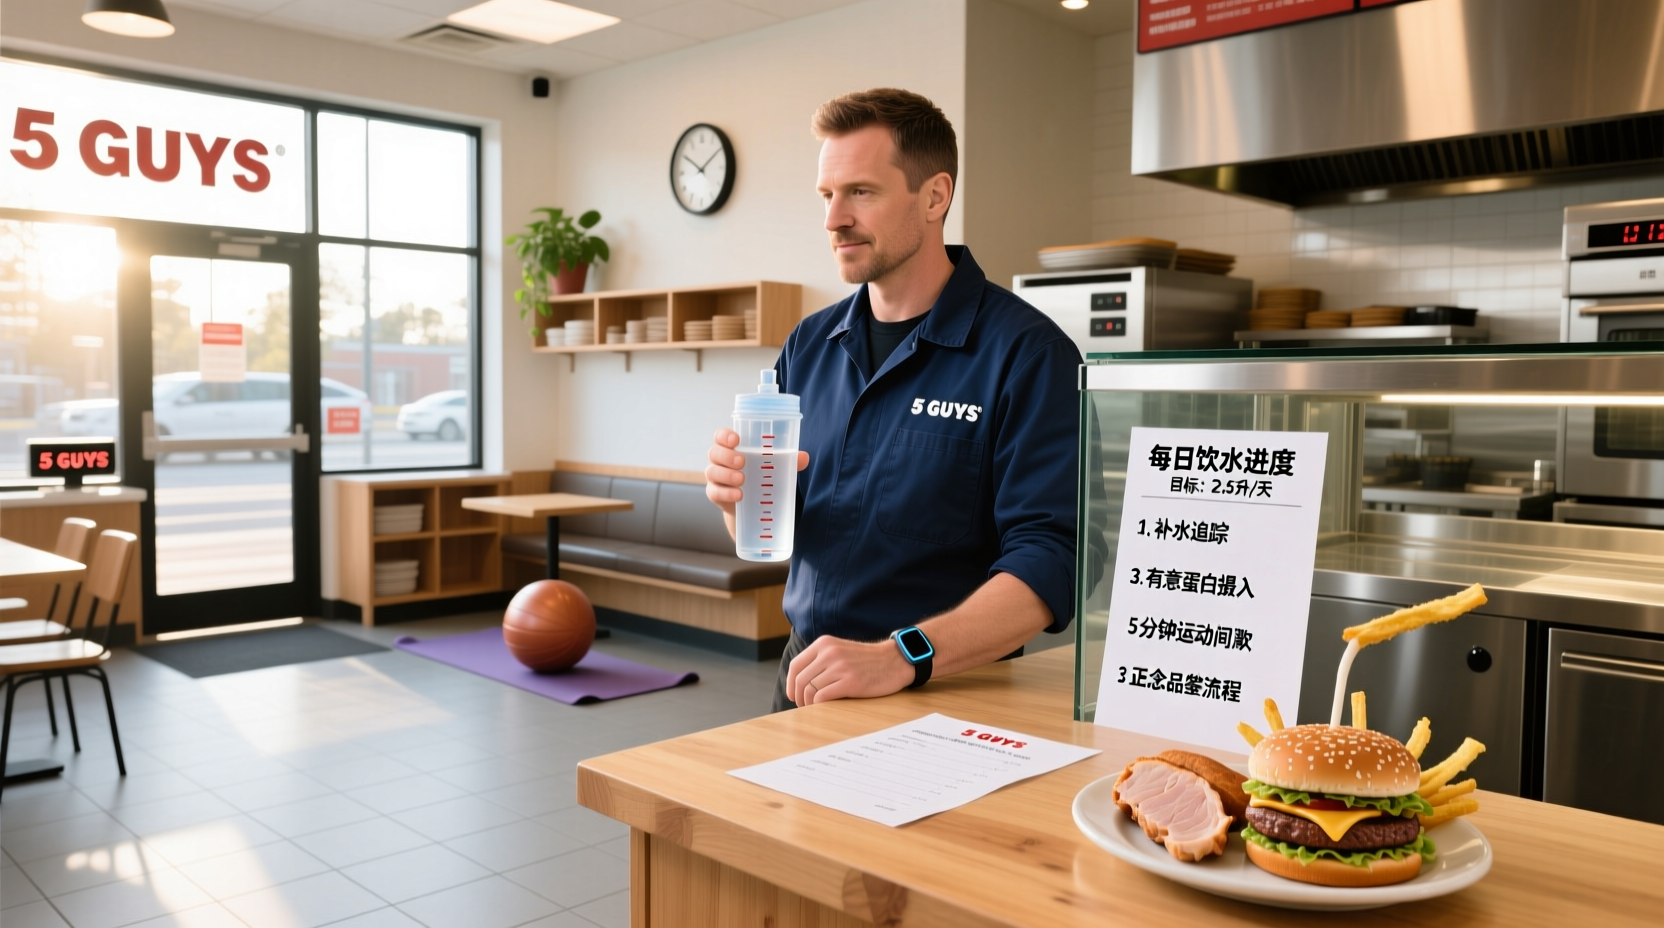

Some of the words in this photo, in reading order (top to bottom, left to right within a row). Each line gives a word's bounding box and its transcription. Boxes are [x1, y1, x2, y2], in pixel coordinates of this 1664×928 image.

[10, 107, 59, 170] 5
[79, 119, 271, 193] GUYS
[911, 398, 926, 415] 5
[38, 452, 53, 470] 5
[56, 450, 109, 470] GUYS
[1148, 444, 1297, 477] 每日饮水进度
